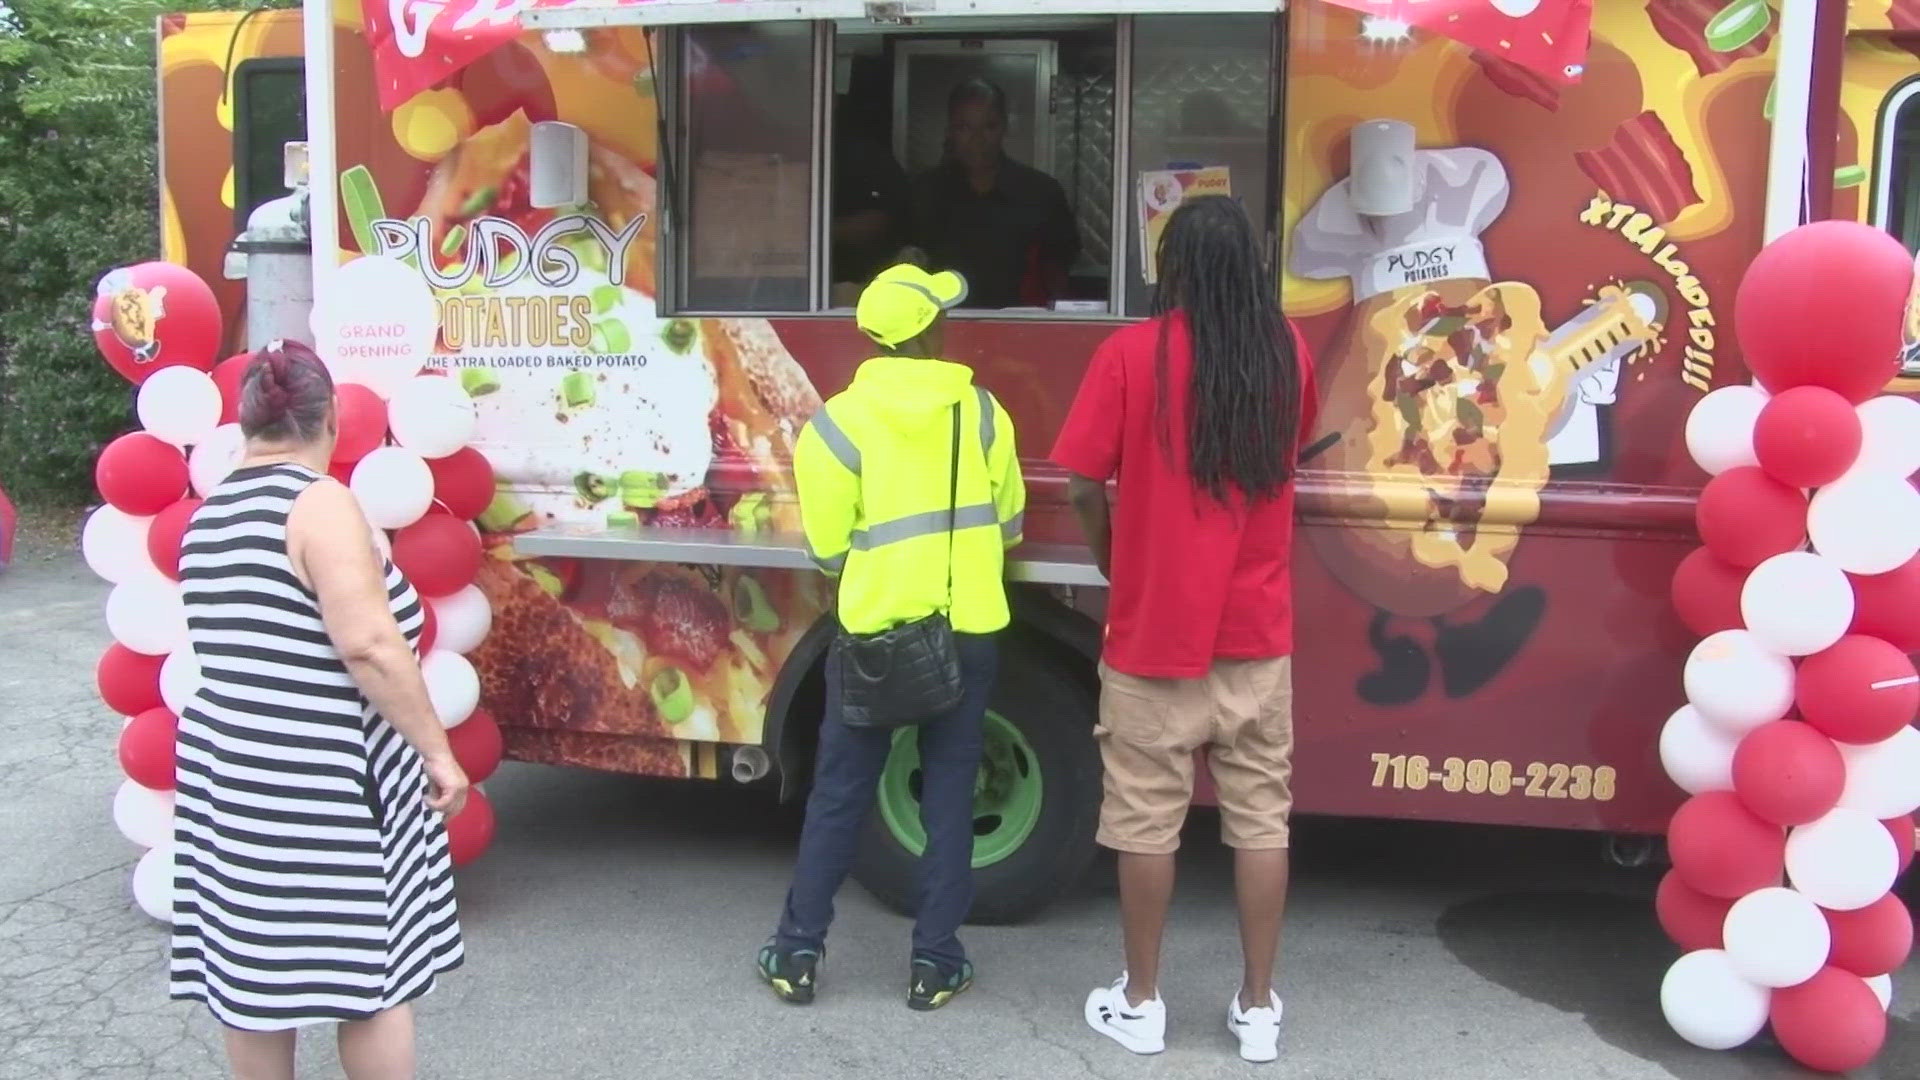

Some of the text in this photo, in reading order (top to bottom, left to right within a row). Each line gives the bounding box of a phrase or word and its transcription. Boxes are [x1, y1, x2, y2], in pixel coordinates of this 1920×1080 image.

[372, 214, 647, 289] PUDGY
[1387, 246, 1456, 273] PUDGY
[1404, 264, 1448, 282] POTATOES
[1580, 197, 1716, 392] XTRA LOADED!!!
[339, 324, 406, 339] GRAND
[435, 296, 593, 348] OTATOES
[337, 344, 412, 358] OPENING
[453, 357, 486, 368] XTRA
[491, 356, 542, 368] LOADED
[547, 355, 592, 367] BAKED
[597, 355, 648, 367] POTATO
[1371, 753, 1616, 801] 716-398-2238
